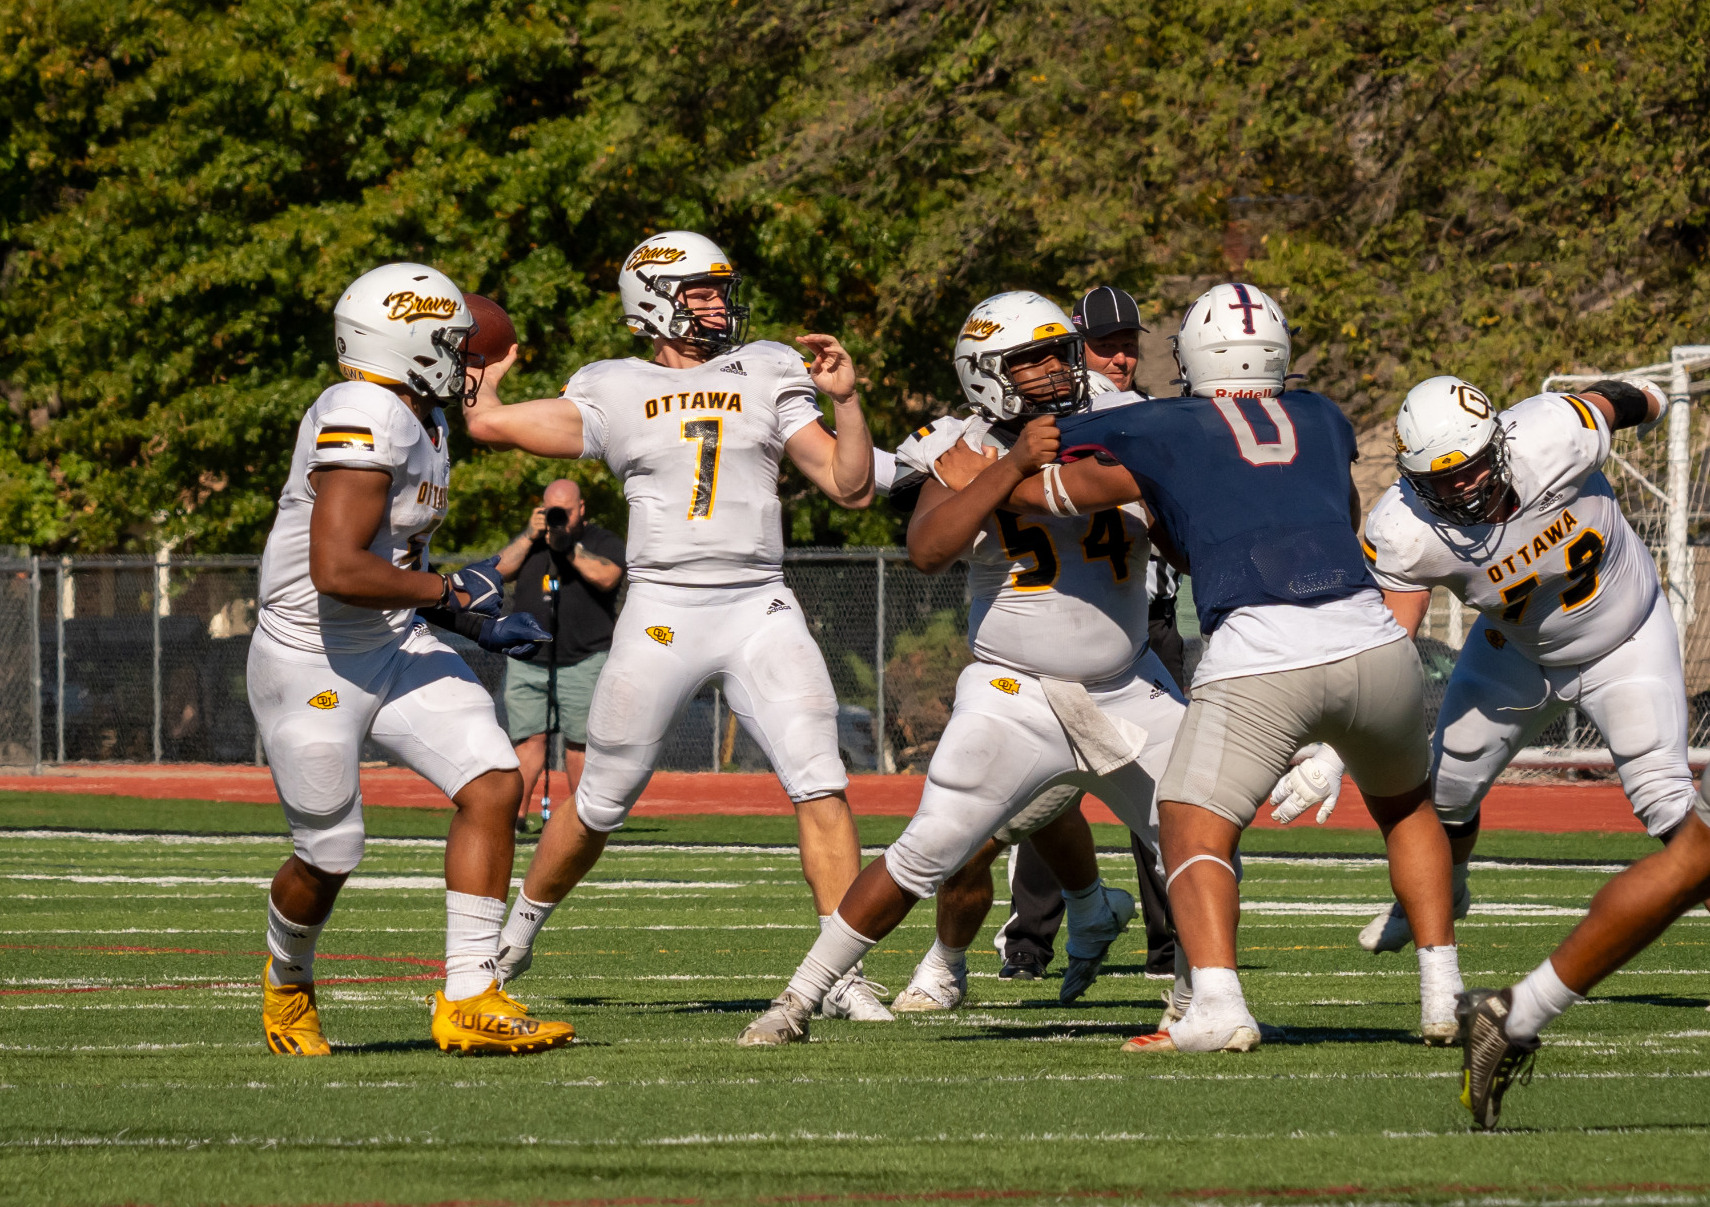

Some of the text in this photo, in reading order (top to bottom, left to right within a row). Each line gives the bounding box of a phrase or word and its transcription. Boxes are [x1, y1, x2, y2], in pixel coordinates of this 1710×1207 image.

[626, 245, 686, 271] Braves
[386, 291, 459, 323] Braves
[720, 366, 748, 376] adidas
[645, 391, 742, 419] OTTAWA
[1215, 388, 1273, 400] Riddell
[680, 416, 723, 520] 7
[1539, 492, 1564, 512] adidas
[993, 504, 1136, 592] 54
[1487, 508, 1579, 584] OTTAWA
[1498, 527, 1605, 626] 79
